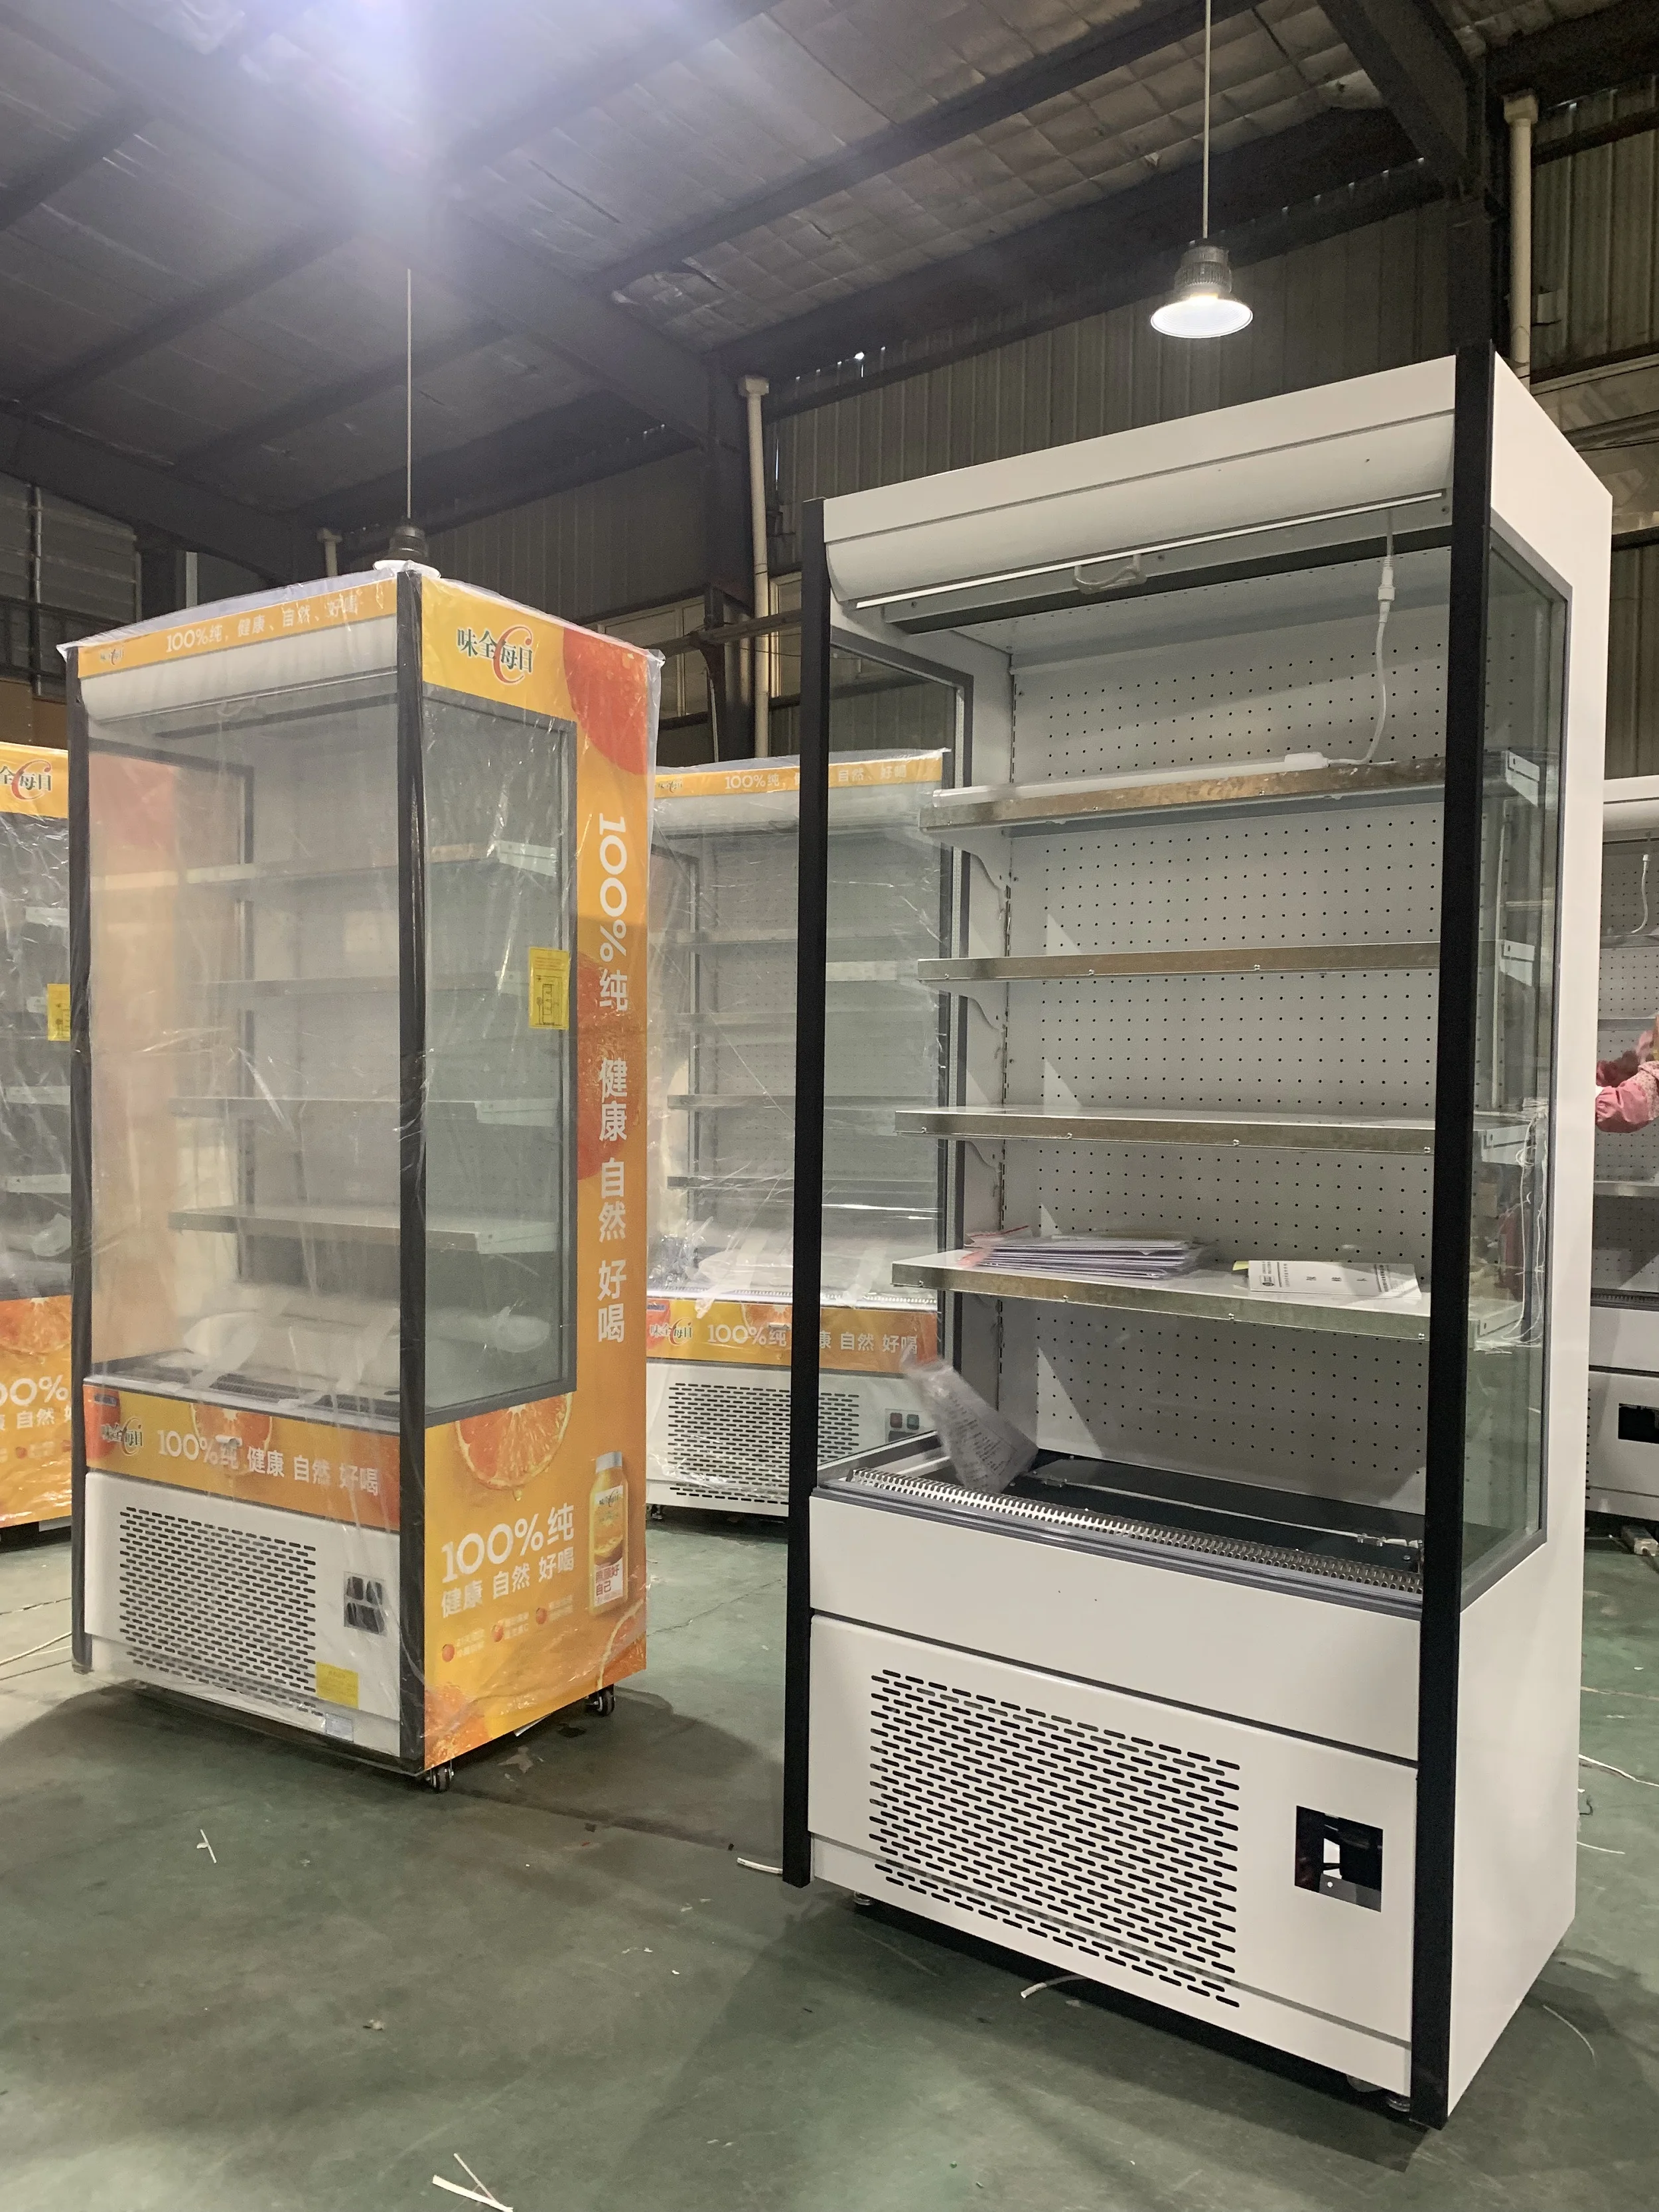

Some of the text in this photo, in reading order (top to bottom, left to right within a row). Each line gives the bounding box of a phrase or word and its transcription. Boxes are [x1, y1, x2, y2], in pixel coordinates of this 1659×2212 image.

[599, 1059, 628, 1142] 健康
[598, 1157, 626, 1244] 自然
[597, 1259, 627, 1343] 好喝
[840, 1332, 875, 1351] 自然
[248, 1445, 285, 1478] 健康
[294, 1454, 331, 1487] 自然
[339, 1462, 379, 1497] 好喝
[493, 1562, 531, 1599] 自然
[539, 1546, 574, 1582] 好喝
